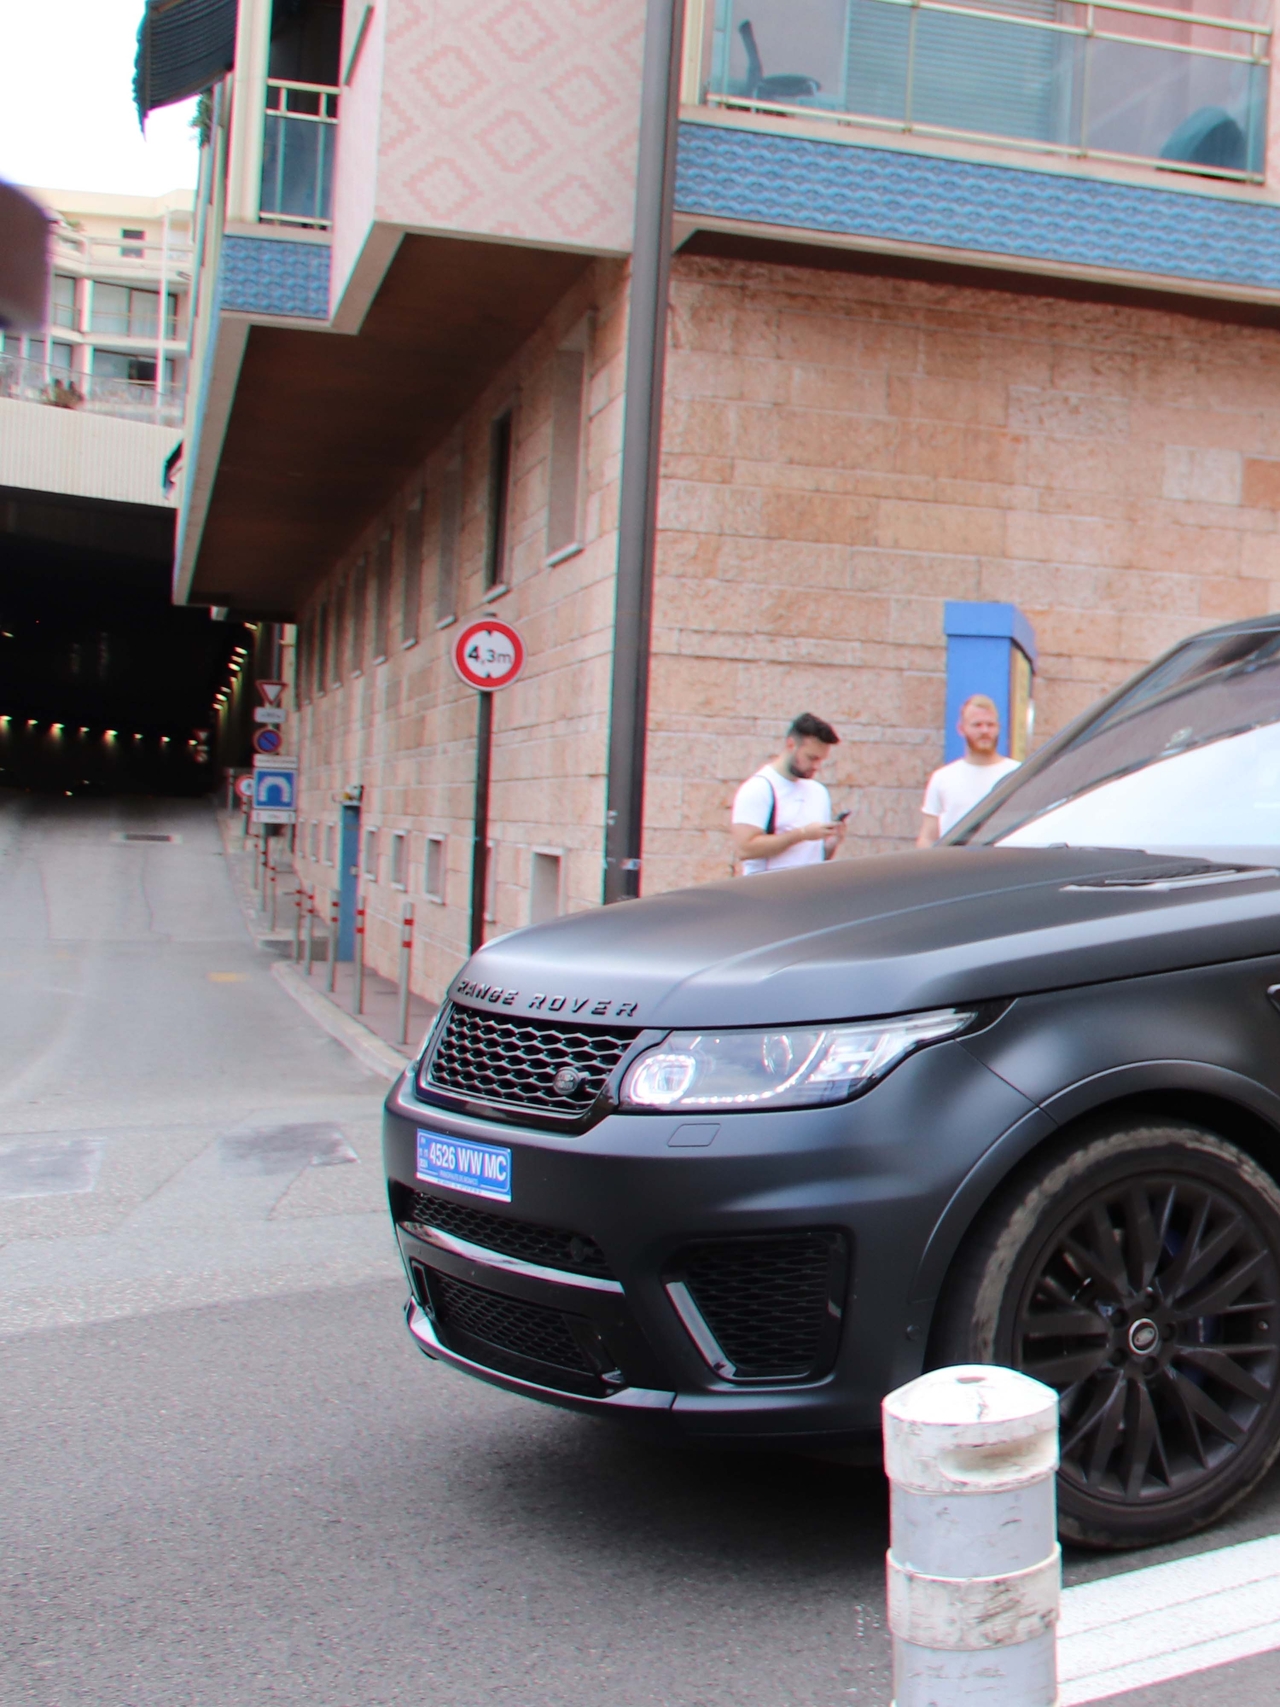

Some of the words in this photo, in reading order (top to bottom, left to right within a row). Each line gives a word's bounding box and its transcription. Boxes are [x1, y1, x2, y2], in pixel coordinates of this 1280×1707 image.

[467, 645, 512, 665] 4,3m
[457, 978, 519, 1005] RANGE
[528, 993, 639, 1017] ROVER
[429, 1142, 456, 1170] 4526
[457, 1147, 483, 1176] WW
[484, 1153, 507, 1181] MC
